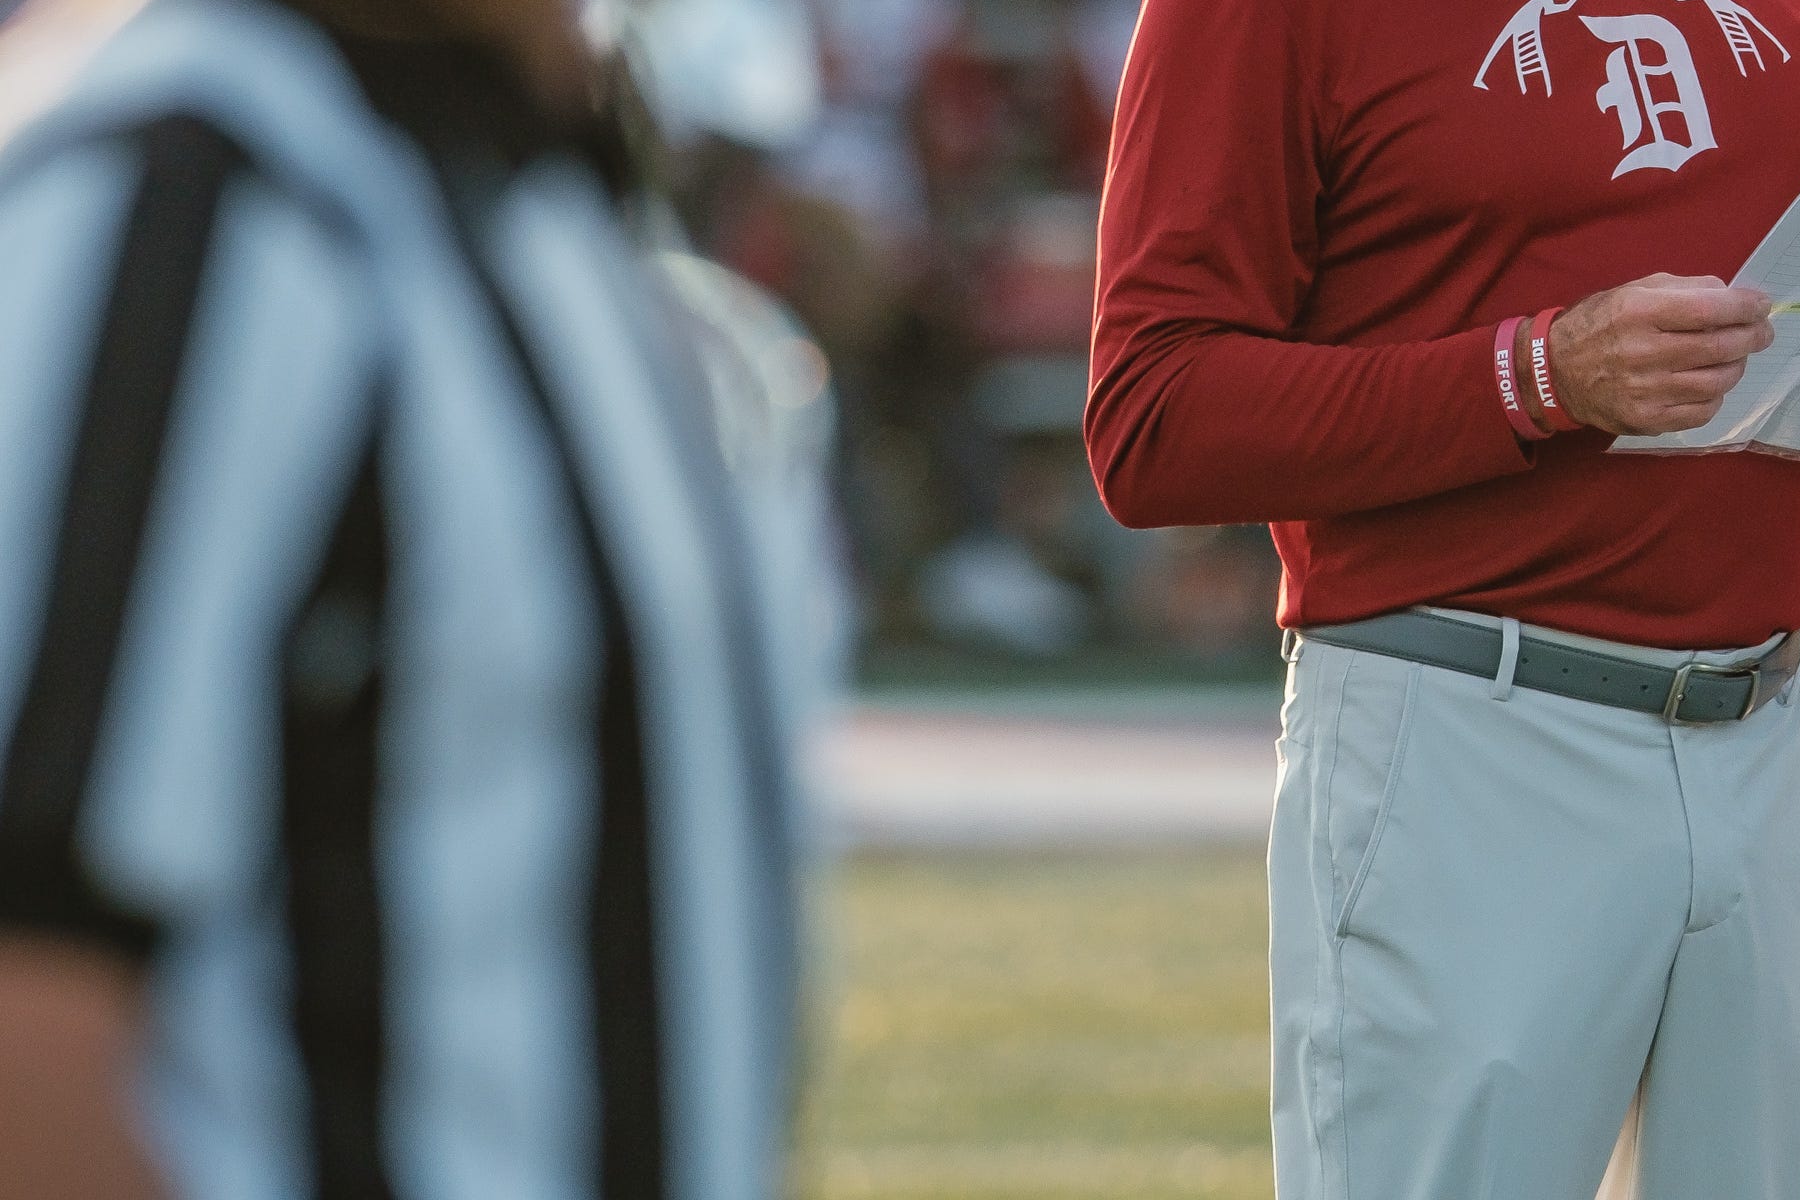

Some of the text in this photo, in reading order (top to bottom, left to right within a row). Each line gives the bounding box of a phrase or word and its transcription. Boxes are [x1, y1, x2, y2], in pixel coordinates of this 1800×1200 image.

[1578, 13, 1719, 181] D
[1496, 349, 1519, 411] EFFORT
[1532, 337, 1557, 408] ATTITUDE
